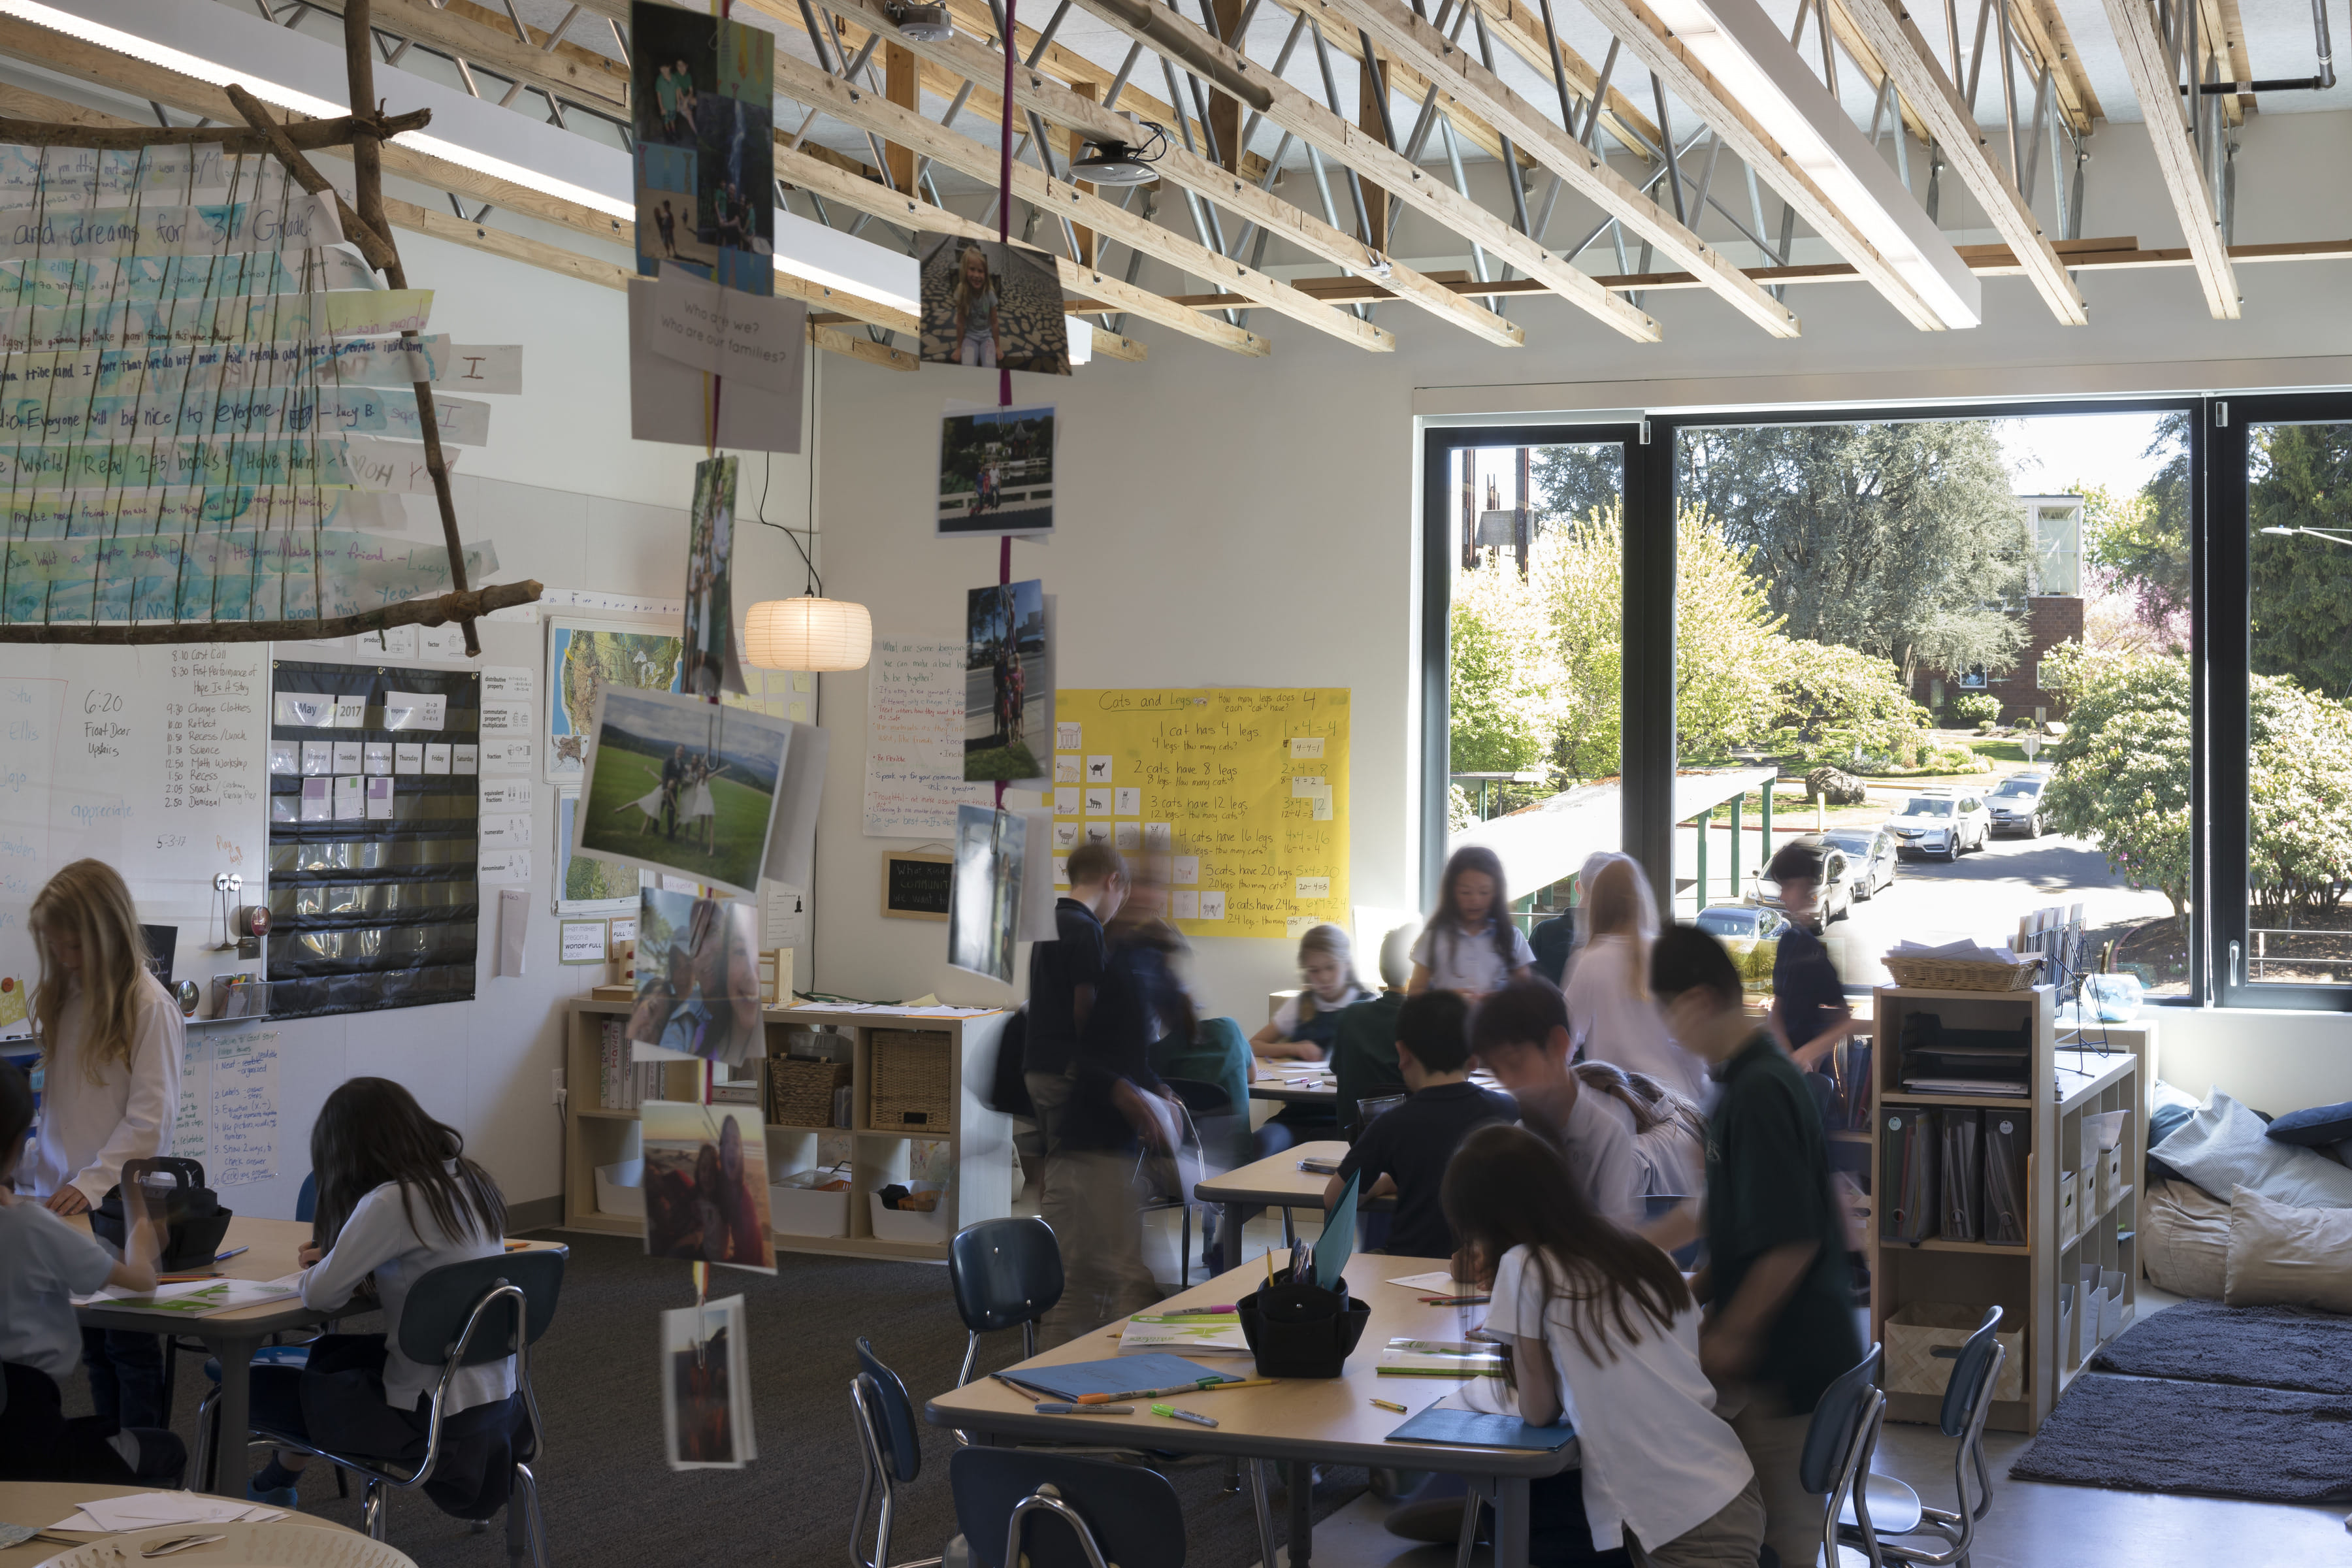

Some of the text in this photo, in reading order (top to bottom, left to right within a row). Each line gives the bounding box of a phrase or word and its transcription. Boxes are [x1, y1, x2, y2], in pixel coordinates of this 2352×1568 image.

[14, 204, 316, 246] and dreams for 3rd Grade?
[685, 300, 760, 334] Who we?
[661, 314, 786, 363] Who are our families?
[27, 408, 80, 434] Everyone
[91, 410, 106, 425] will
[121, 410, 137, 426] be
[145, 408, 171, 426] nice
[188, 406, 203, 424] to
[336, 404, 359, 427] Lucy
[85, 455, 122, 475] Read
[246, 451, 279, 469] Have
[191, 649, 208, 660] Cast
[211, 649, 226, 659] Call
[171, 663, 258, 678] 8:30 First Performance of
[194, 680, 249, 696] Hope Is A Story
[84, 689, 123, 713] 6:20
[1100, 691, 1192, 710] Cats and Legs
[1218, 691, 1316, 710] How many legs does 4
[167, 702, 252, 717] 9:30 Change Clothes
[299, 703, 362, 717] May 2017
[84, 721, 131, 738] Front Door
[188, 717, 216, 728] Reflect
[1169, 723, 1189, 736] cat
[1196, 722, 1216, 734] has
[1222, 721, 1229, 736] 4
[188, 731, 218, 741] Recess
[88, 742, 120, 758] Upstairs
[189, 743, 220, 755] Science
[191, 757, 248, 771] Math Workshop
[339, 753, 357, 762] Tuesday
[366, 754, 390, 762] Wednesday
[190, 769, 218, 781] Recess
[1134, 760, 1237, 781] 2 cats have 8 legs
[165, 783, 212, 794] 2:05 Snack
[165, 796, 221, 808] 2:50 Dismissal
[1151, 796, 1249, 814] 3 cats have 12 legs
[156, 834, 186, 849] 5-3-17
[1179, 827, 1252, 843] 4 cats have 16
[1239, 864, 1257, 875] have
[1260, 864, 1275, 877] 20
[1256, 898, 1275, 911] have
